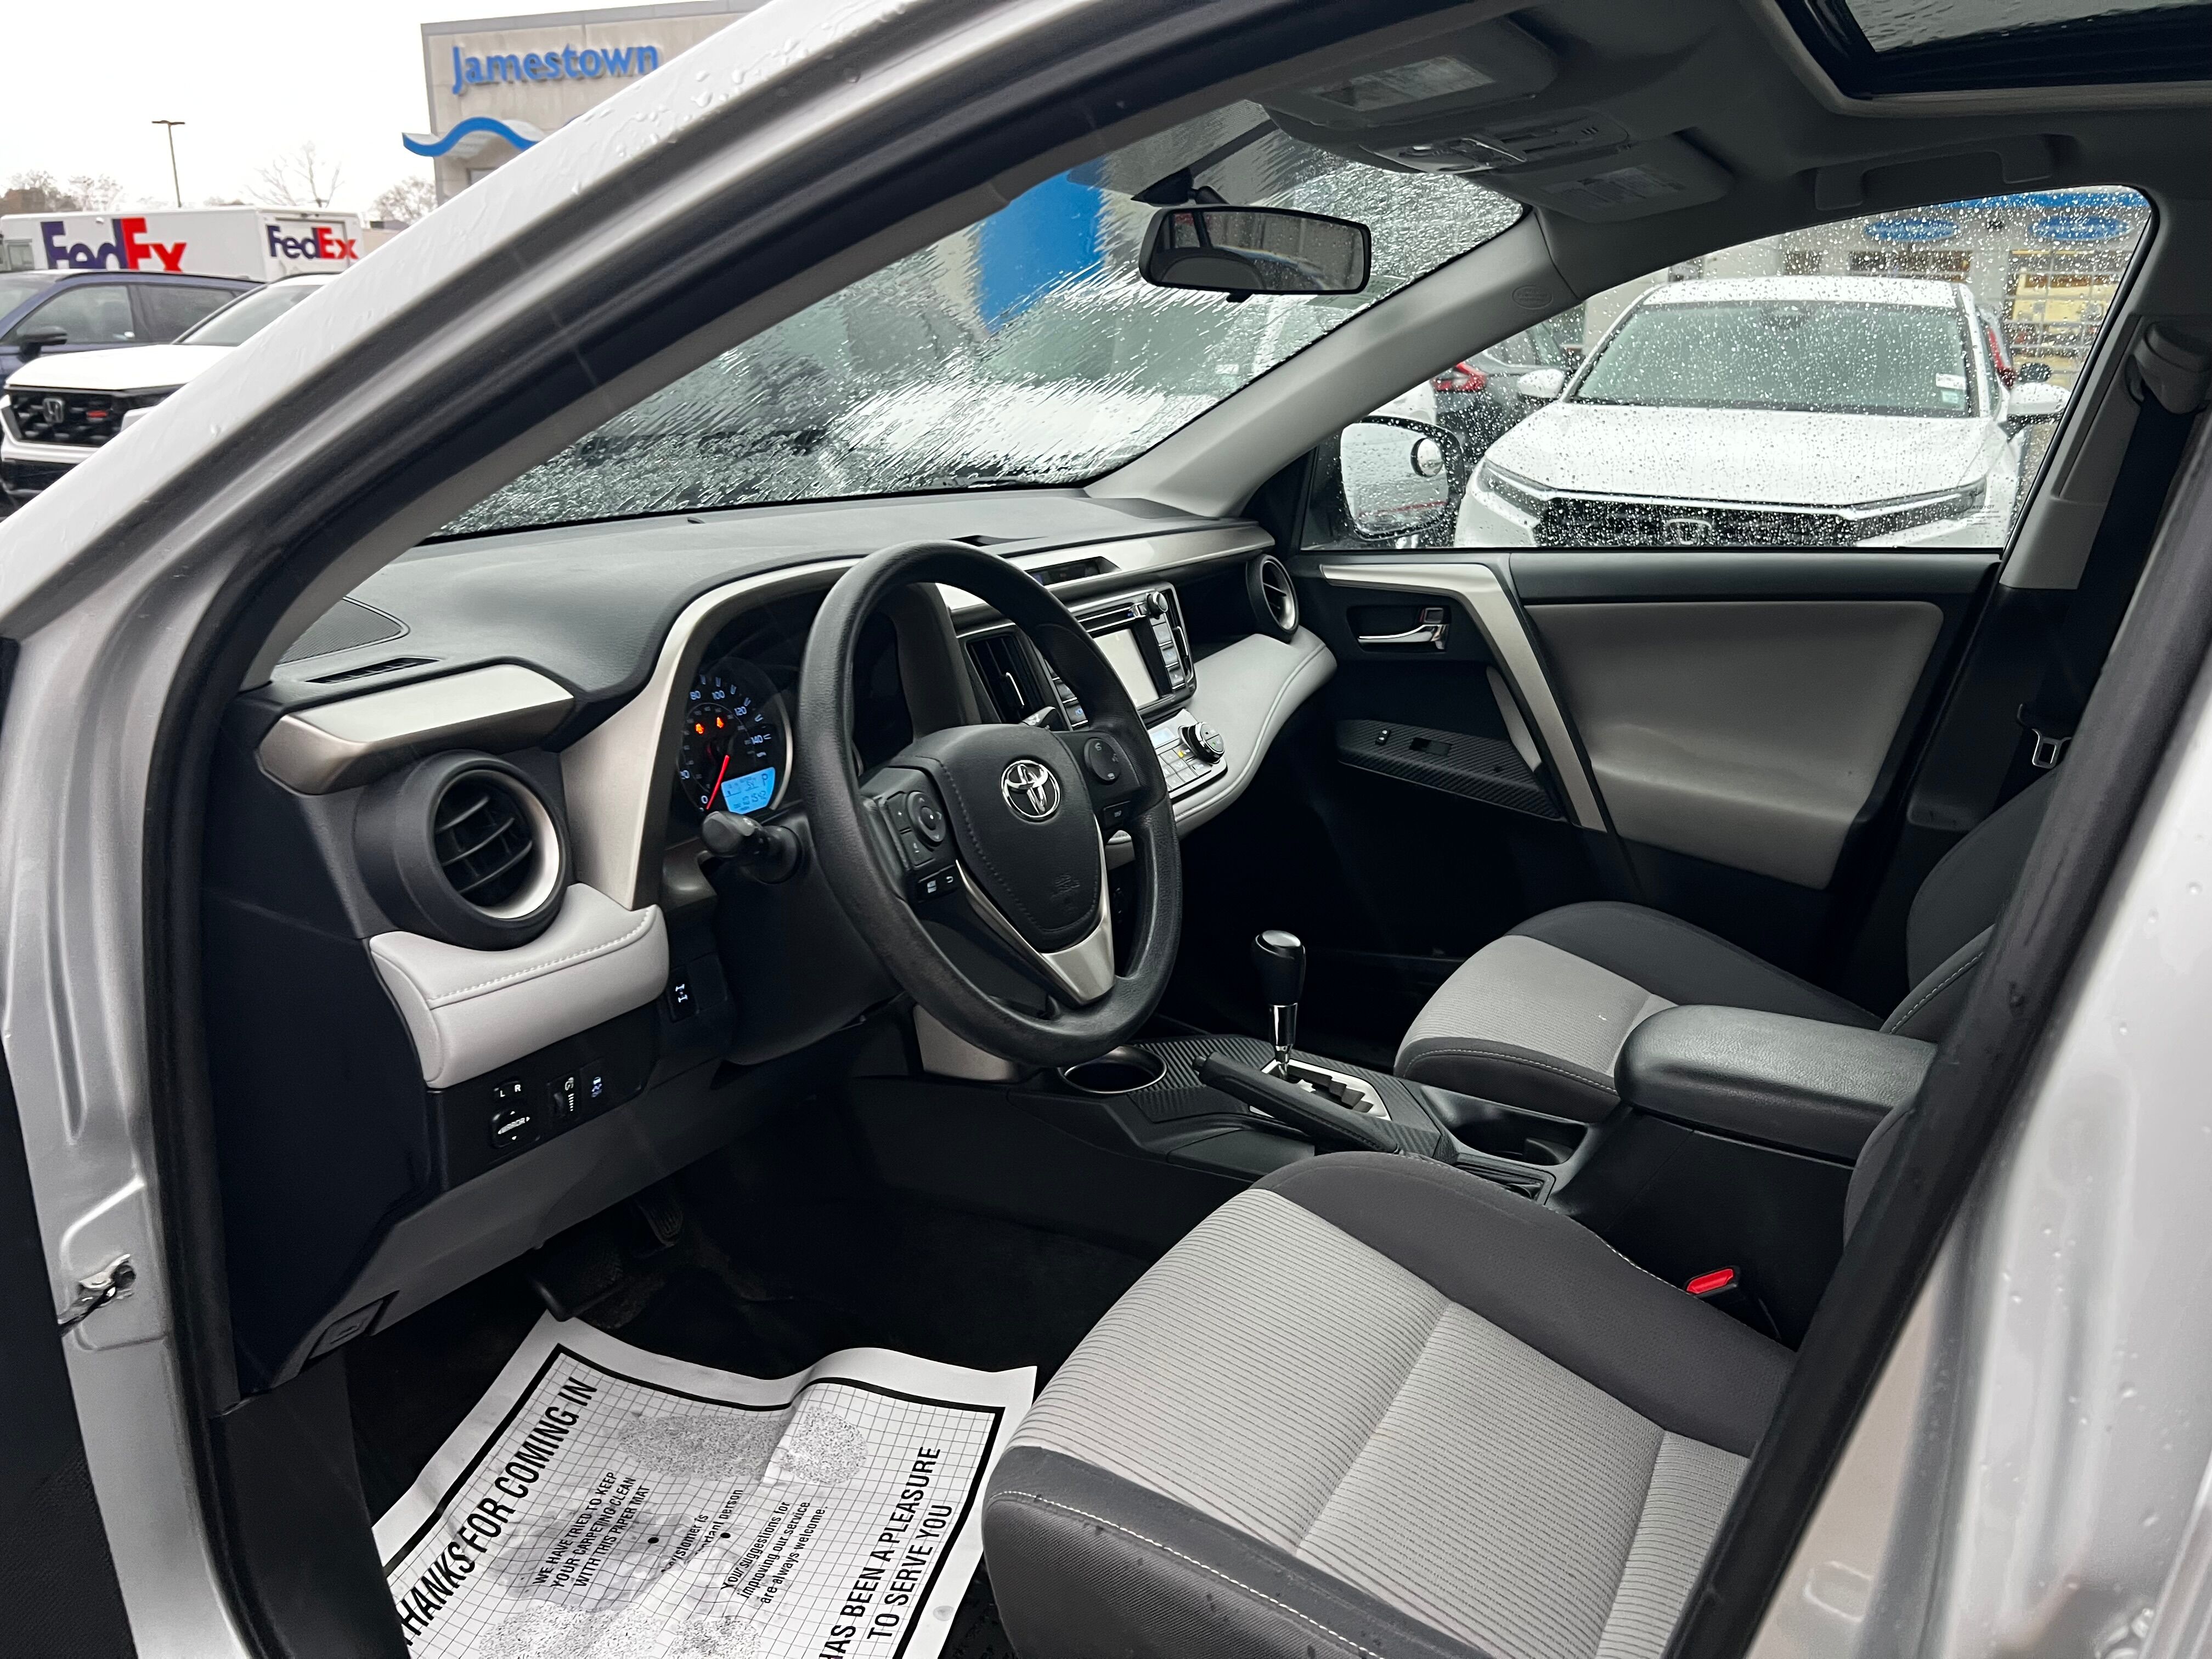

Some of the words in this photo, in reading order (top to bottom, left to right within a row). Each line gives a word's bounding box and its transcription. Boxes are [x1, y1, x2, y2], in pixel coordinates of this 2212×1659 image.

[452, 43, 657, 95] Jamestown
[41, 217, 187, 272] FedEx
[267, 224, 359, 259] FedEx
[515, 1084, 521, 1092] R
[400, 1542, 475, 1646] HANKS
[457, 1498, 516, 1553] FOR
[494, 1406, 579, 1498] COMING
[557, 1377, 597, 1406] IN
[532, 1567, 554, 1584] WE
[545, 1539, 573, 1564] HAVE
[564, 1513, 592, 1538] TRIED
[585, 1498, 602, 1510] TO
[595, 1472, 617, 1495] KEEP
[550, 1558, 580, 1587] YOUR
[572, 1507, 616, 1555] CARPETING
[609, 1477, 636, 1506] CLEAN
[573, 1558, 601, 1587] WITH
[592, 1535, 617, 1556] THIS
[607, 1507, 637, 1536] PAPER
[629, 1485, 650, 1505] MAT
[694, 1515, 709, 1523] is
[719, 1489, 743, 1519] person
[878, 1446, 941, 1544] PLEASURE
[720, 1567, 743, 1589] Your
[740, 1516, 782, 1568] suggestions
[774, 1502, 791, 1514] for
[737, 1554, 780, 1599] improving
[772, 1536, 789, 1552] our
[784, 1502, 810, 1534] service
[760, 1586, 777, 1604] are
[772, 1552, 800, 1584] always
[794, 1506, 828, 1550] welcome.
[867, 1613, 900, 1639] TO
[884, 1544, 933, 1606] SERVE
[916, 1505, 952, 1539] YOU
[870, 1550, 895, 1562] A
[840, 1567, 885, 1617] BEEN
